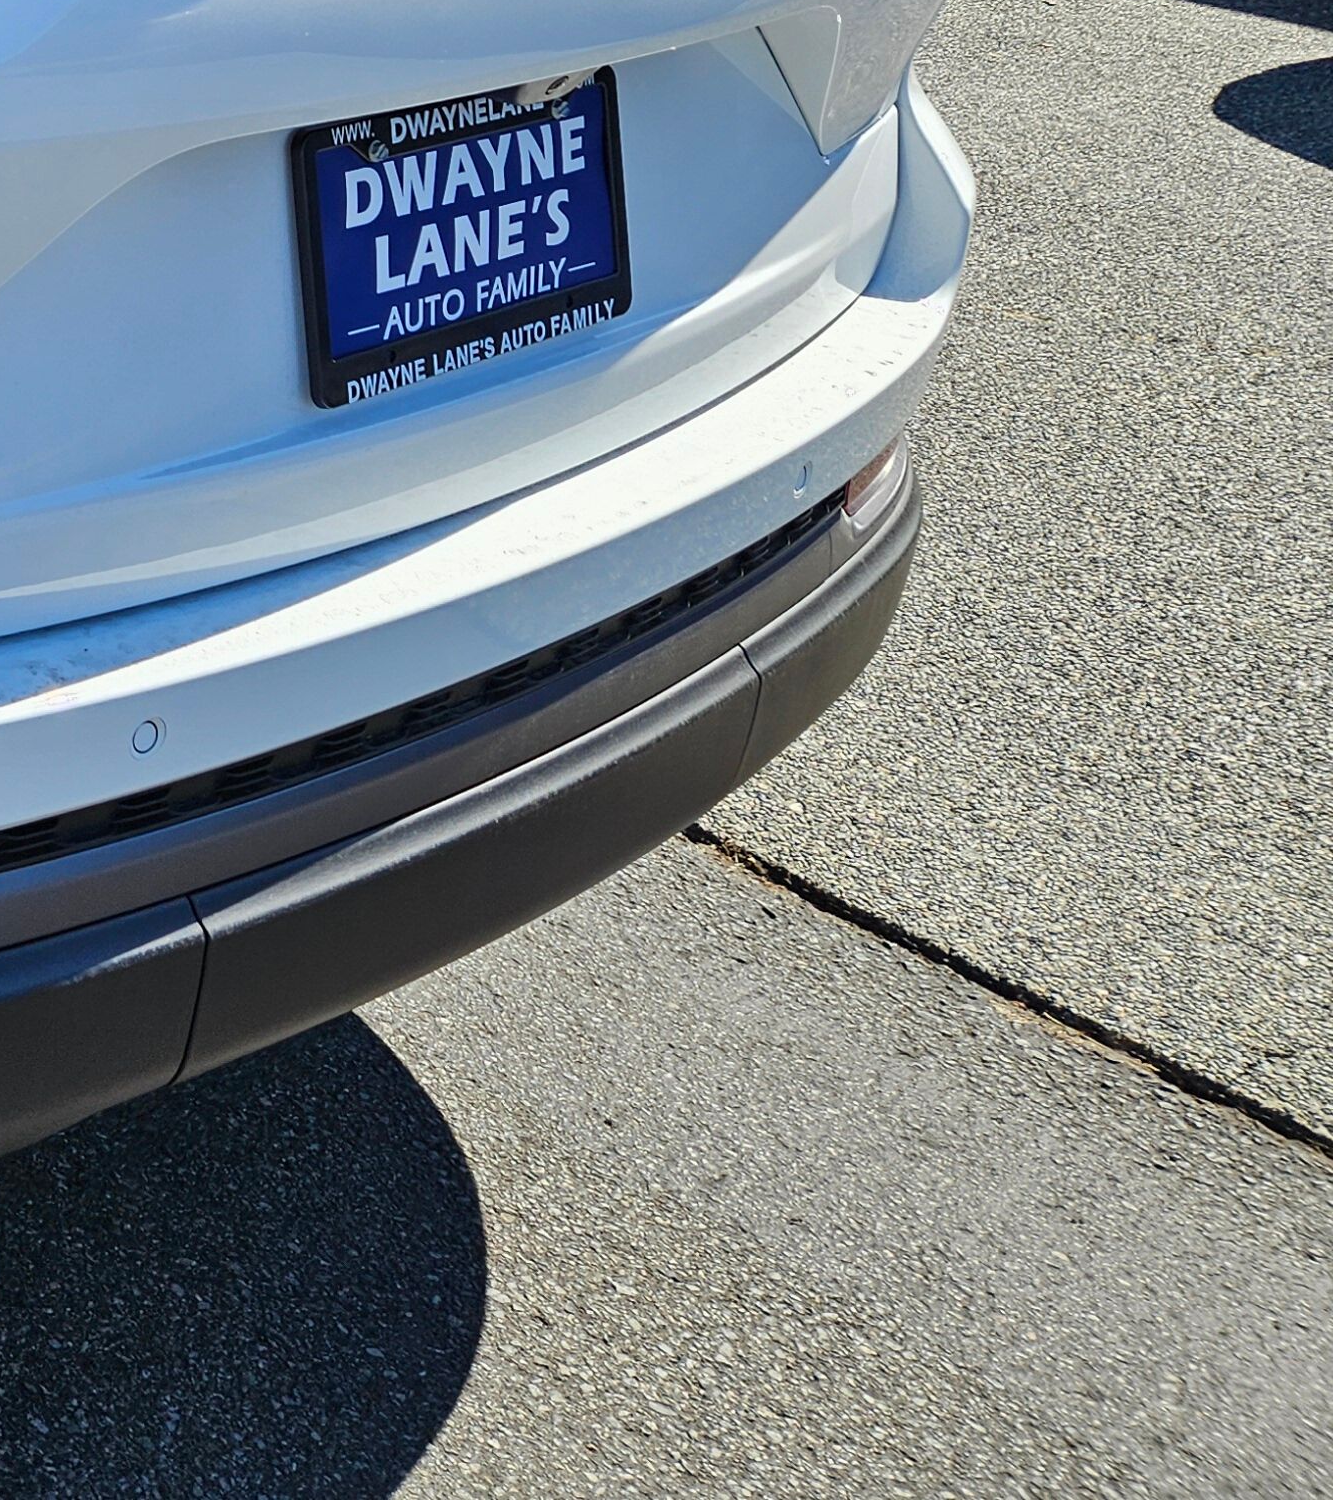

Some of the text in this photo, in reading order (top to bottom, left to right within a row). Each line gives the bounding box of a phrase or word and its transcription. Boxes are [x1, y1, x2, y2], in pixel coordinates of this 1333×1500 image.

[331, 120, 376, 146] WWW.
[345, 115, 585, 229] DWAYNE
[375, 188, 570, 294] LANE'S
[347, 298, 616, 404] DWAYNE LANE'S AUTO FAMILY
[383, 257, 567, 340] AUTO FAMILY
